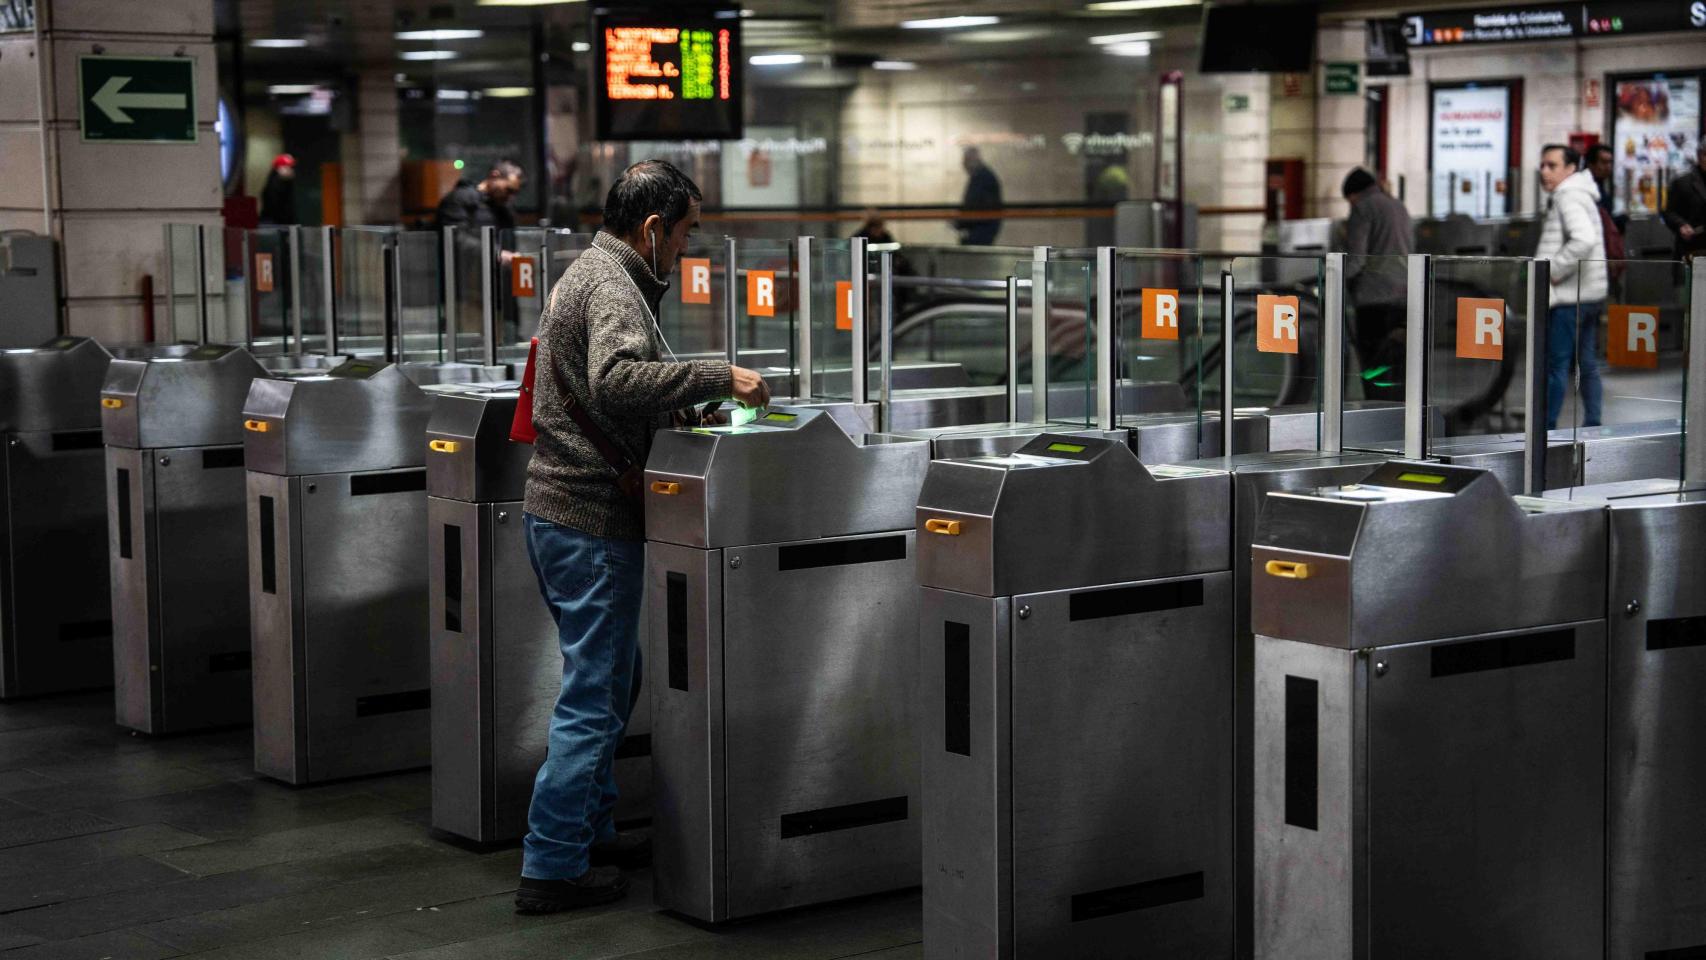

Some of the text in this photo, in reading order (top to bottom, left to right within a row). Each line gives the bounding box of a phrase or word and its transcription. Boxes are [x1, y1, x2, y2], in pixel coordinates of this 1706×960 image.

[262, 260, 272, 283] R
[519, 263, 532, 289] R
[692, 266, 710, 293] R
[757, 277, 774, 306] R
[1156, 294, 1177, 328] R
[1273, 304, 1297, 340] R
[1474, 308, 1503, 346] R
[1627, 312, 1656, 353] R
